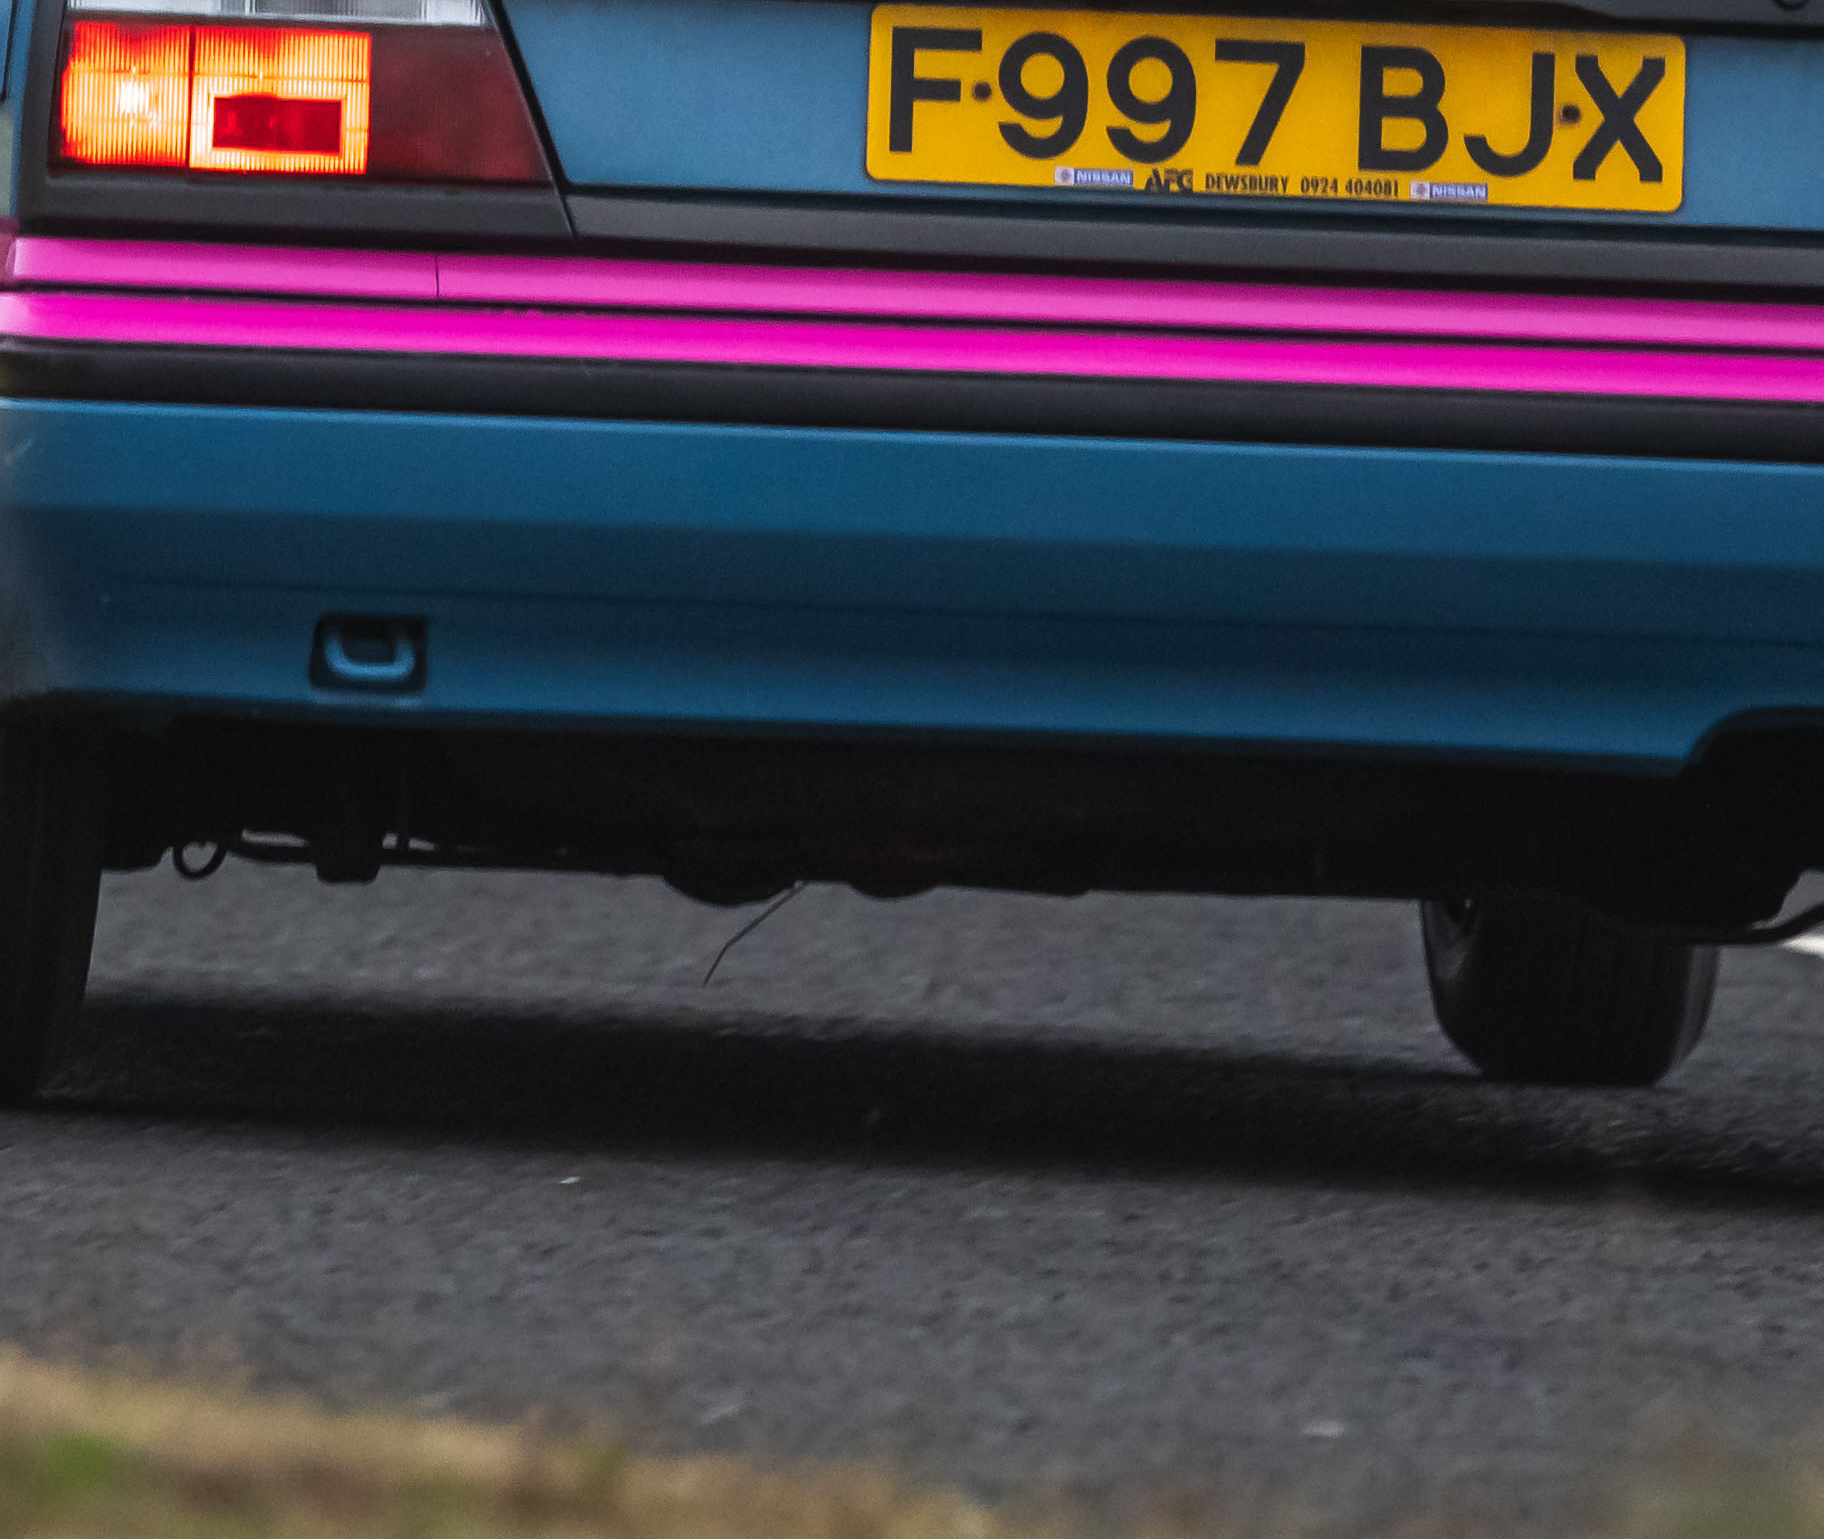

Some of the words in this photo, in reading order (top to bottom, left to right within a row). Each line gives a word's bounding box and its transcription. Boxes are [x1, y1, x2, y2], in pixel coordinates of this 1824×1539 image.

[889, 26, 1307, 166] F997
[1357, 45, 1666, 182] BJX
[1206, 173, 1289, 194] DEWSBURY
[1300, 176, 1339, 196] 0924
[1345, 178, 1399, 198] 404081
